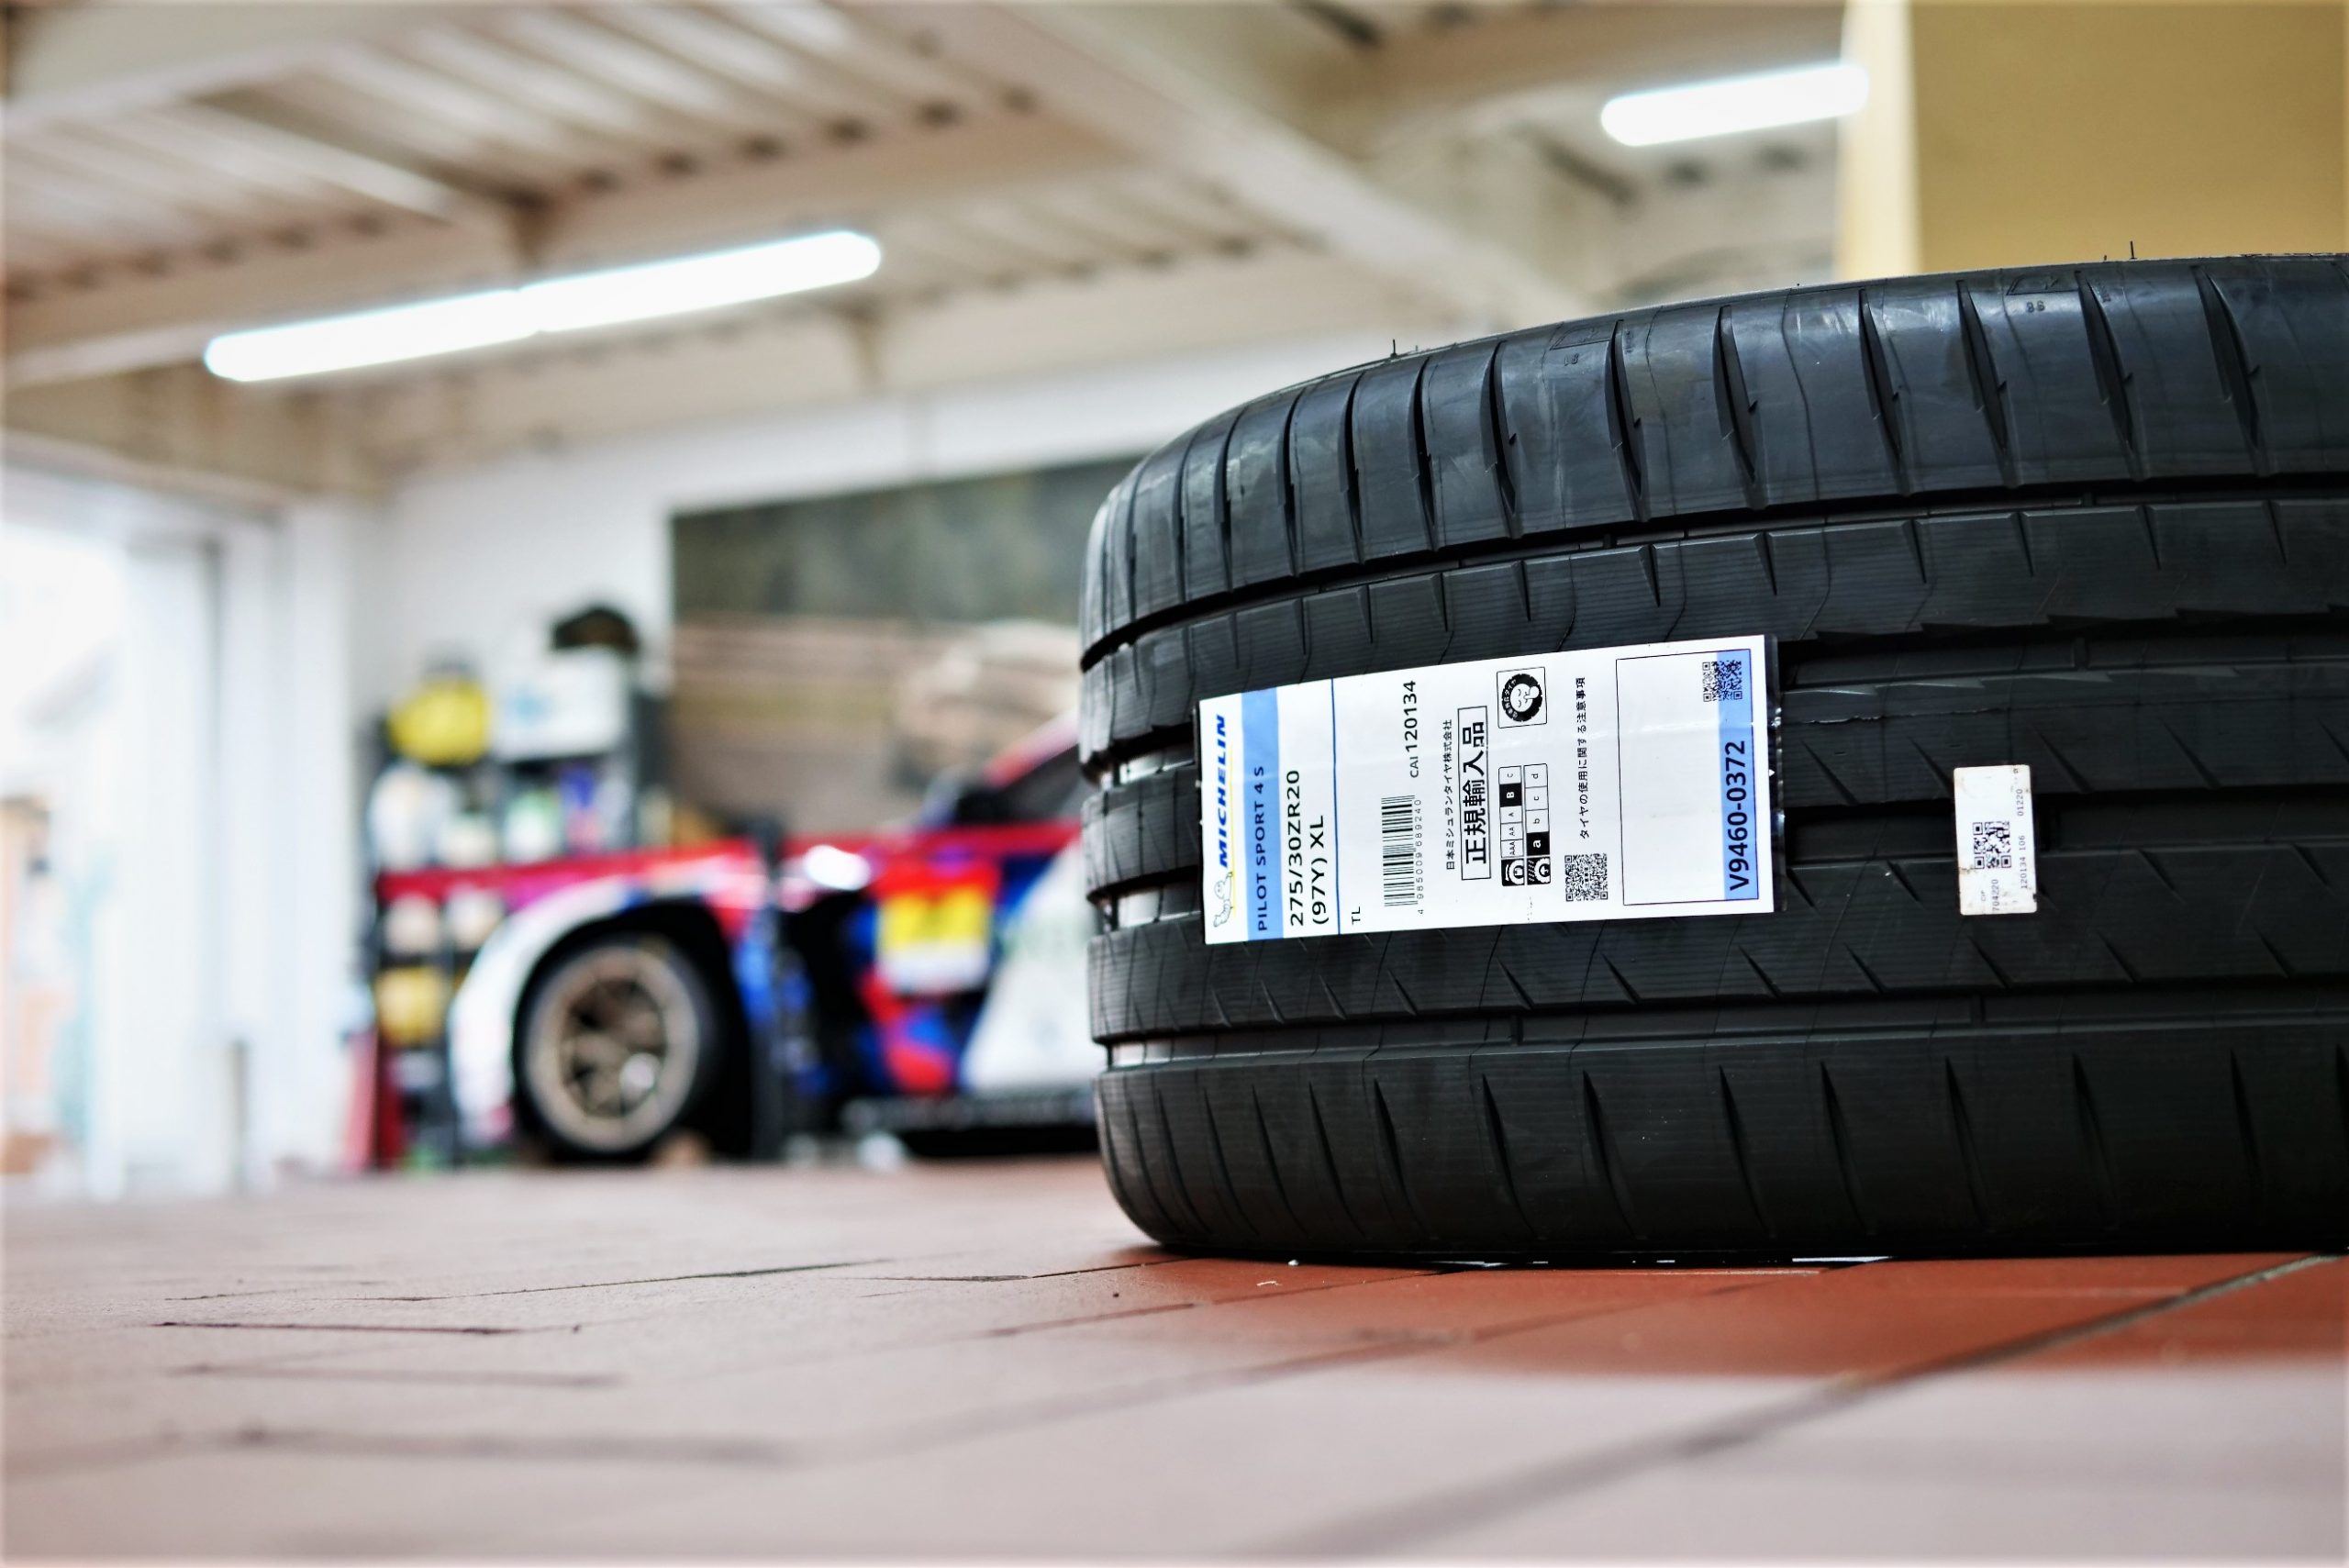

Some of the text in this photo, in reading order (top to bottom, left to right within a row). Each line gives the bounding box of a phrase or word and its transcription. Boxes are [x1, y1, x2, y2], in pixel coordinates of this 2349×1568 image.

[1216, 714, 1229, 868] MICHELIN
[1402, 680, 1419, 778] CAI 120134
[1442, 719, 1455, 870] 日本ミシュランタイヤ株式会社
[1462, 721, 1486, 864] 正規輸入品
[1506, 791, 1515, 799] B
[1575, 677, 1589, 840] タイヤの使用に関する注意事項
[1254, 766, 1267, 931] PILOT SPORT 4 S
[1286, 770, 1304, 927] 275/30ZR20
[1309, 815, 1329, 925] (97Y) XL
[1724, 740, 1750, 891] V9460-0372
[1351, 906, 1361, 925] TL
